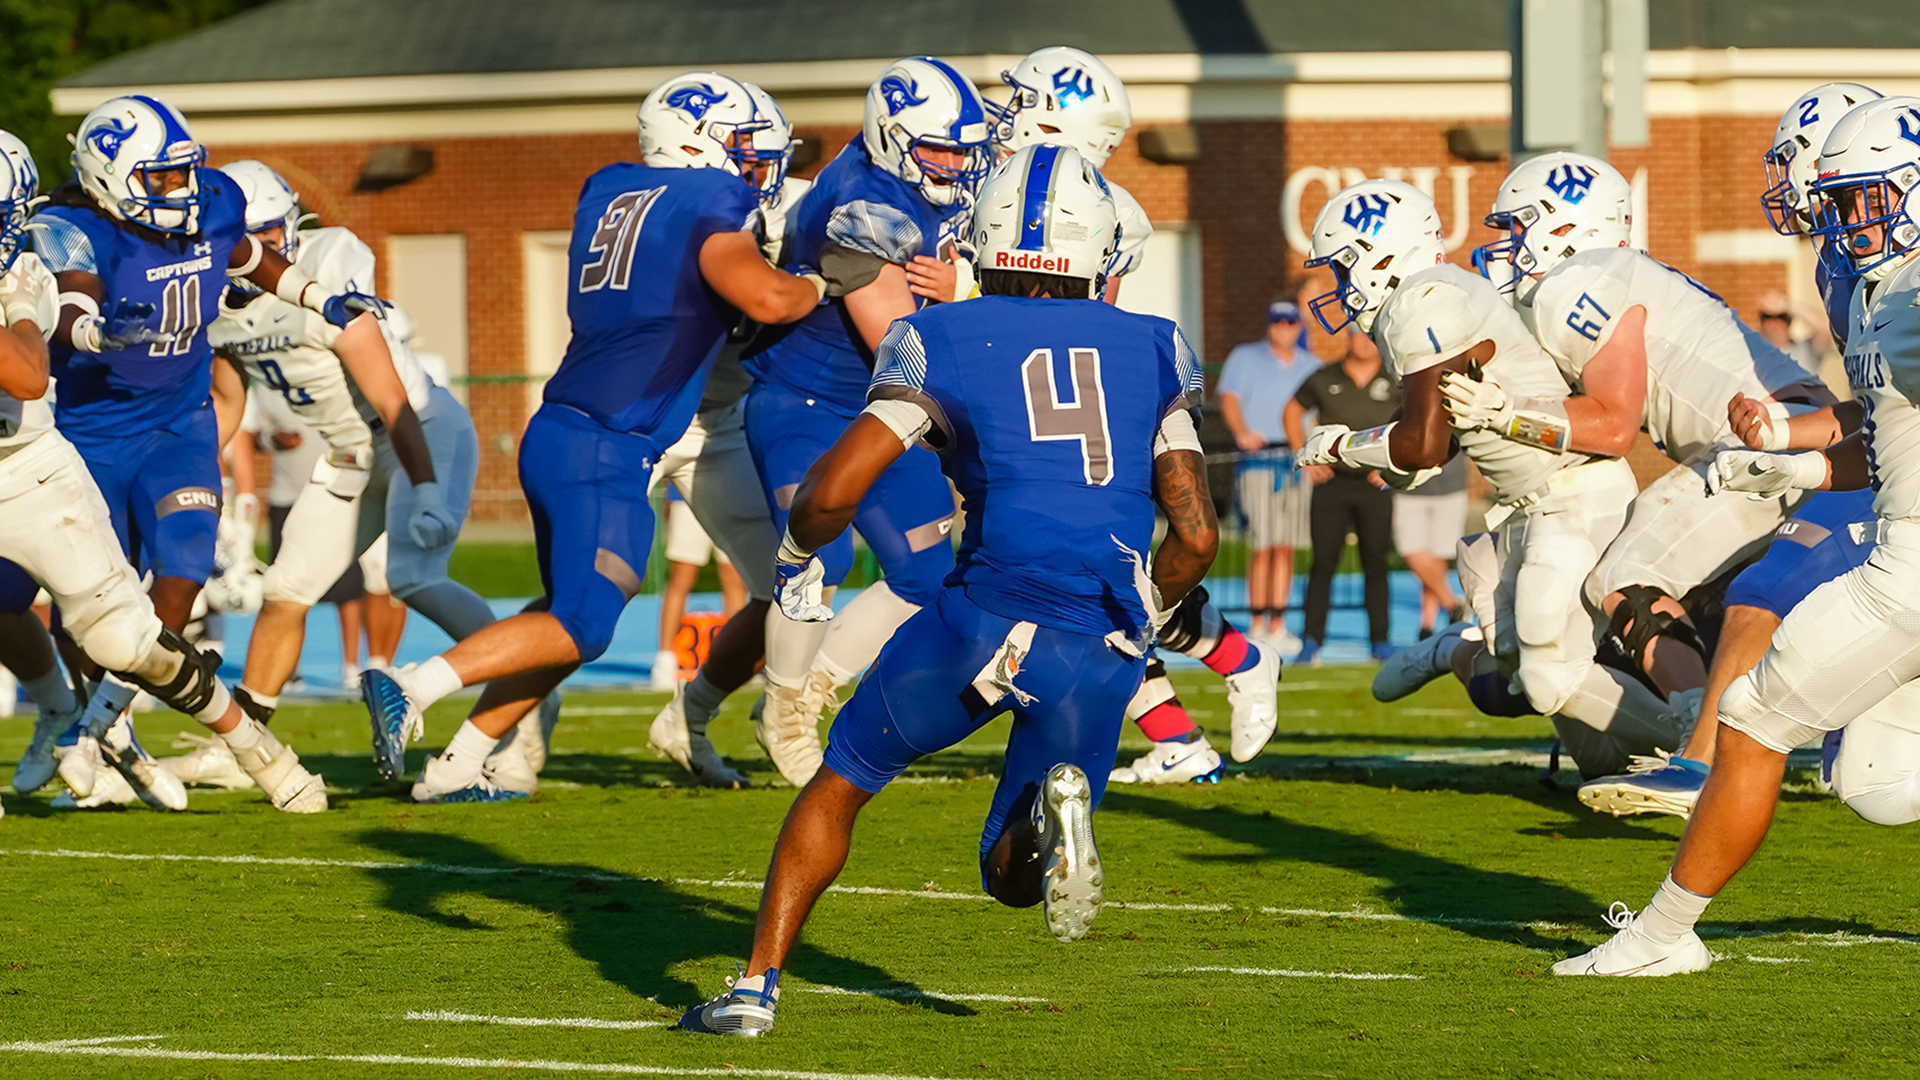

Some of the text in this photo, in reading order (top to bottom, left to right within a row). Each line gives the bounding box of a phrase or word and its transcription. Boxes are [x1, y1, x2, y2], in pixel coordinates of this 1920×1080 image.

[1799, 97, 1819, 128] 2
[1280, 166, 1477, 257] CU
[579, 185, 668, 293] 91
[146, 256, 212, 282] CAPTAINS
[996, 252, 1070, 273] Riddell
[149, 274, 202, 357] 11
[1566, 292, 1621, 341] 67
[1427, 326, 1442, 354] 1
[1021, 347, 1115, 486] 4
[175, 491, 218, 508] CNU
[1775, 522, 1800, 537] NU
